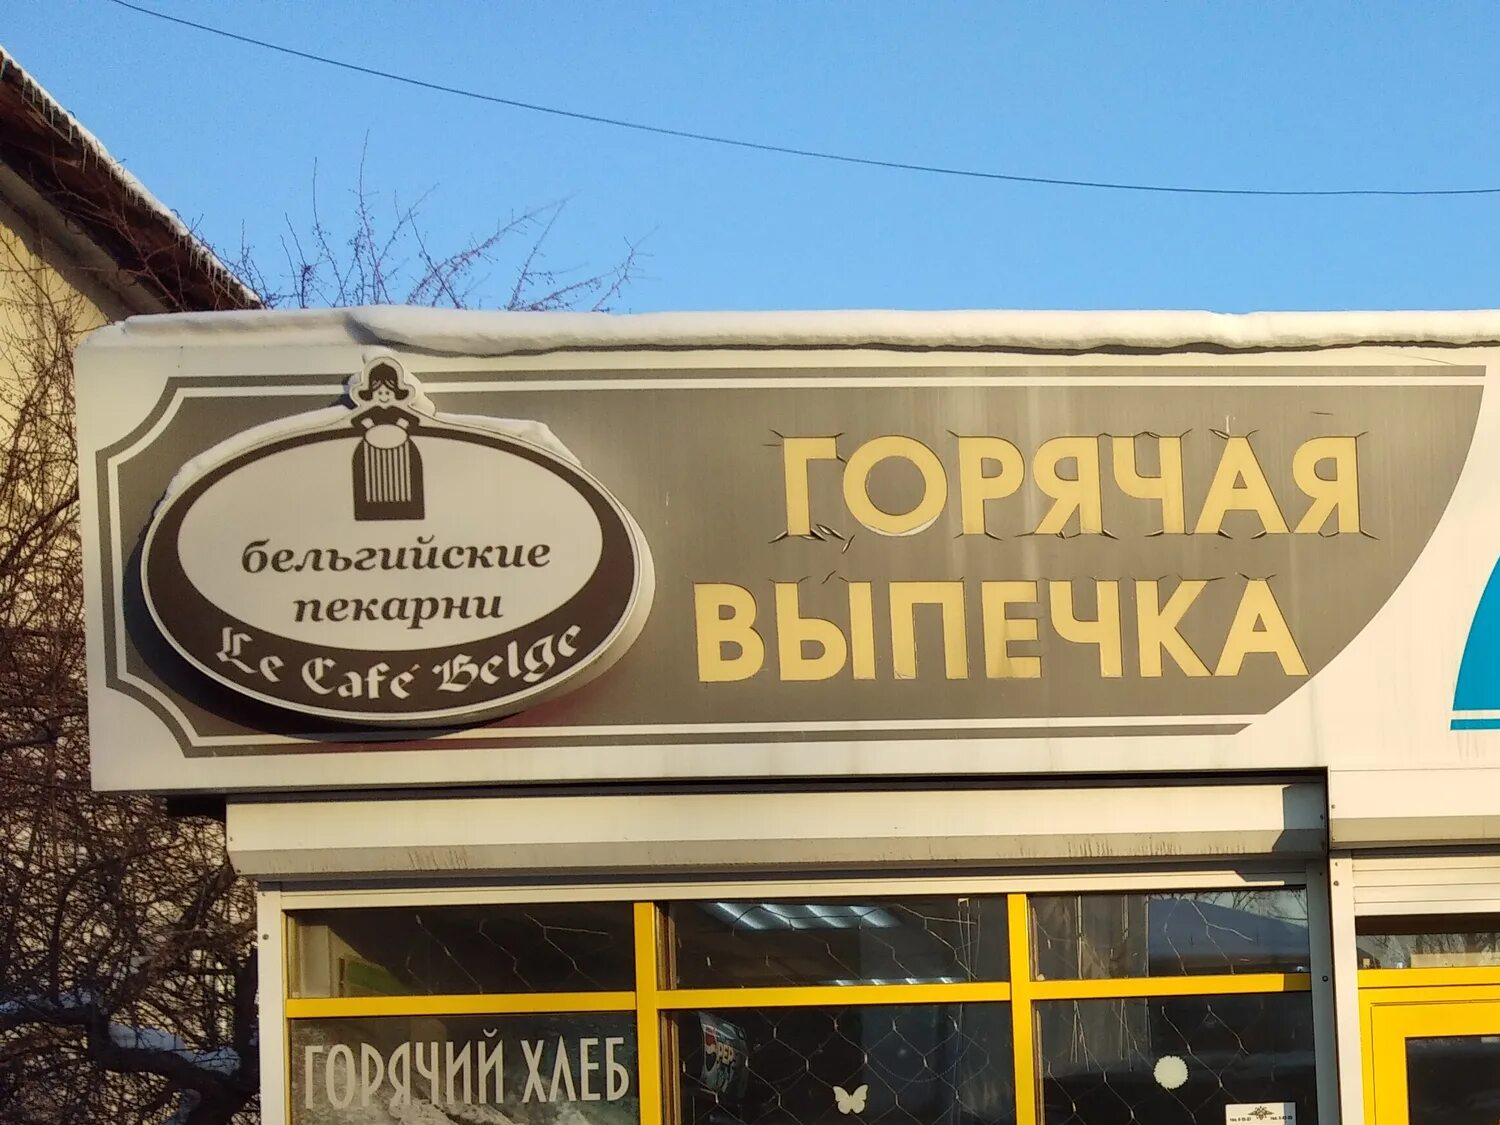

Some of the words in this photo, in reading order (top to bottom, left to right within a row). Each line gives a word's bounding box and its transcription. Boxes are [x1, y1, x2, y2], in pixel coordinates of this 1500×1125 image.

[783, 435, 1362, 536] ГОРЯЧАЯ
[241, 534, 551, 574] бельгийские
[293, 591, 504, 630] пекарни
[694, 578, 1310, 682] ВЫПЕЧКА
[215, 625, 283, 683] Le
[301, 654, 419, 699] Café
[432, 621, 582, 694] Belge
[304, 1028, 504, 1110] ГОРЯЧИЙ
[520, 1034, 630, 1103] ХЛЕБ
